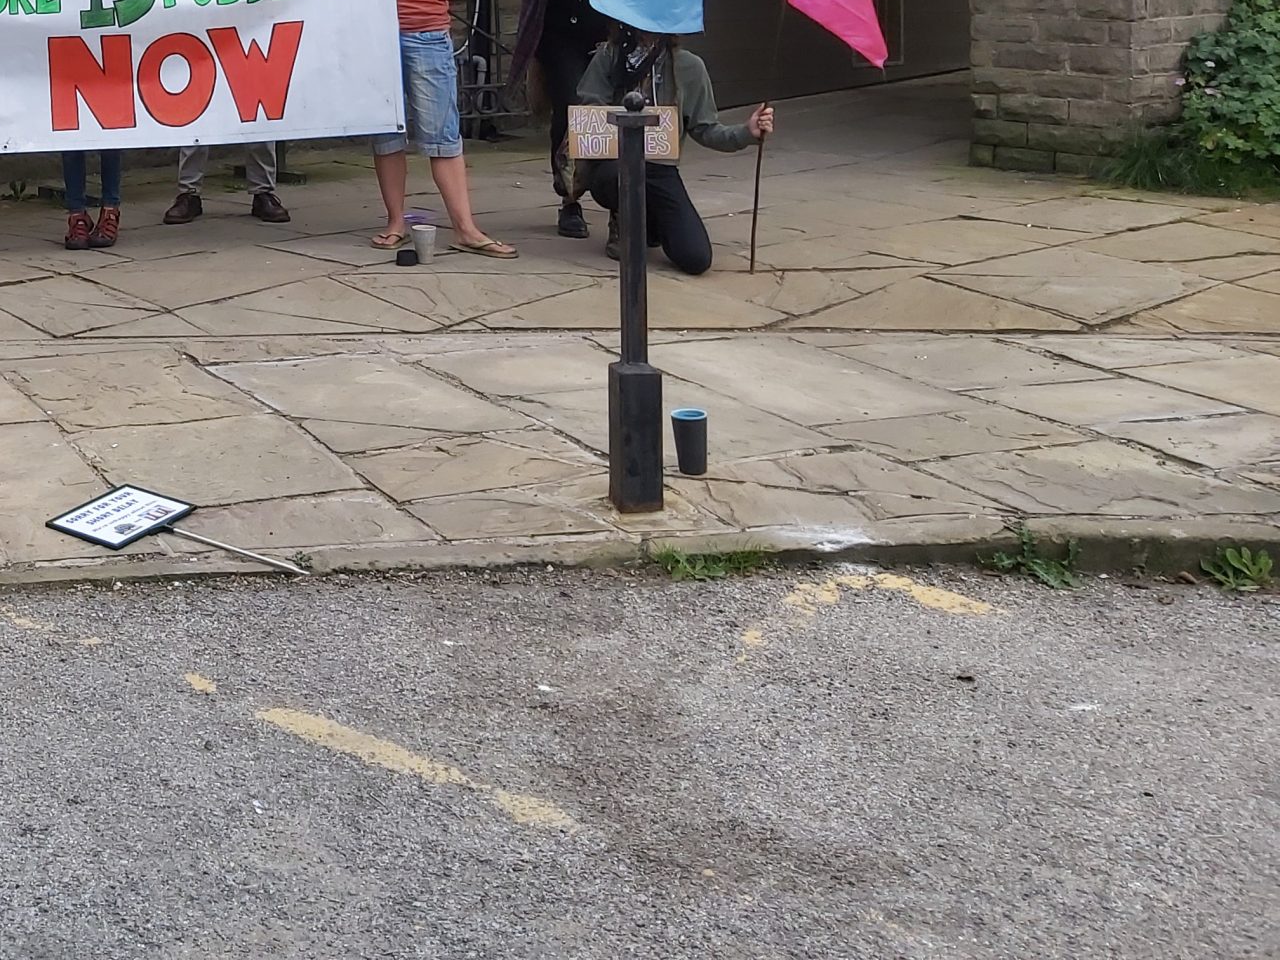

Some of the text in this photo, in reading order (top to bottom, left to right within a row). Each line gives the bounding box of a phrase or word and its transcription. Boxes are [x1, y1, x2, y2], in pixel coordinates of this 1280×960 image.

[47, 20, 305, 132] NOW
[578, 134, 613, 158] NOT
[66, 491, 133, 524] SORRY FOR YOUR
[86, 499, 139, 525] SHORT DELAY
